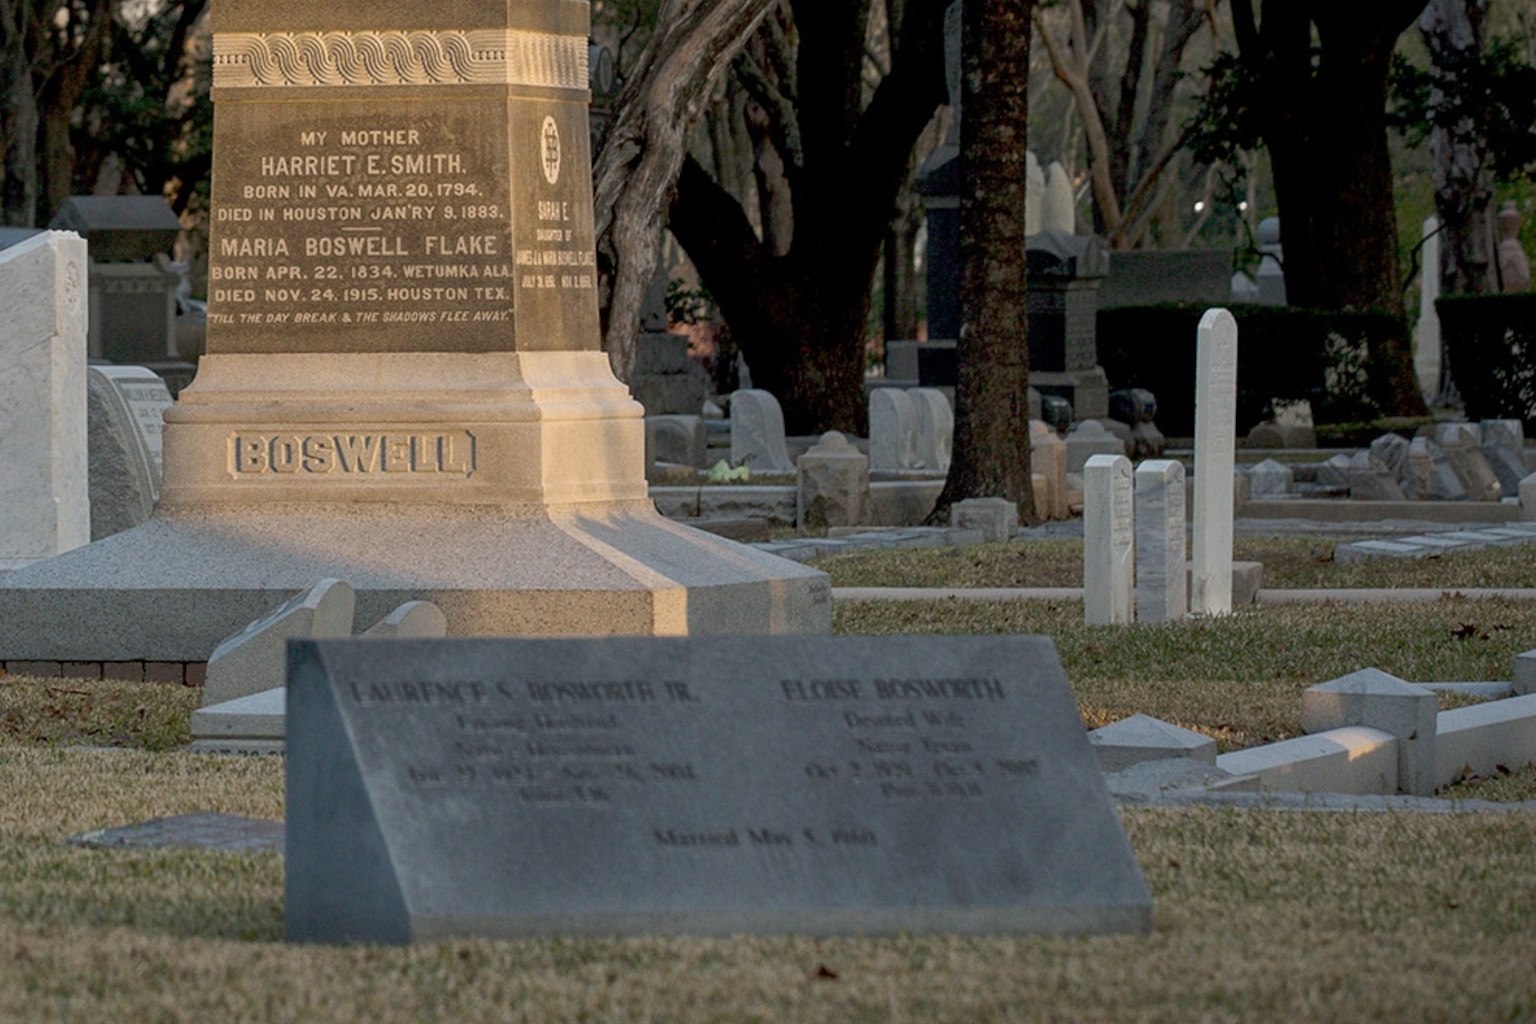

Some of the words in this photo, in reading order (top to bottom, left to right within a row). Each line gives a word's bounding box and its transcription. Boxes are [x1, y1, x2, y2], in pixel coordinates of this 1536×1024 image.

[300, 131, 328, 146] MY
[341, 129, 420, 146] MOTHER
[261, 155, 357, 177] HARRIET
[367, 155, 386, 176] E.
[390, 154, 467, 176] SMITH.
[243, 185, 290, 199] BORN
[298, 185, 317, 199] IN
[326, 185, 354, 199] VA.
[357, 184, 402, 199] MAR.
[437, 183, 483, 198] 1794.
[217, 208, 252, 221] DIED
[259, 207, 275, 221] IN
[283, 207, 361, 221] HOUSTON
[369, 204, 436, 221] JAN'RY
[461, 205, 504, 220] 1883.
[221, 237, 289, 257] MARIA
[305, 236, 409, 257] BOSWELL
[425, 235, 498, 256] FLAKE
[211, 266, 258, 280] BORN
[265, 265, 308, 280] APR.
[351, 264, 398, 280] 1834.
[403, 264, 479, 279] WETUMKA
[482, 264, 513, 278] ALA.
[214, 288, 256, 302] DIED
[265, 288, 306, 302] NOV.
[343, 287, 383, 302] 1915.
[387, 287, 468, 301] HOUSTON
[473, 287, 510, 301] TEX.
[239, 313, 263, 324] THE
[265, 313, 291, 324] DAY
[294, 312, 337, 324] BREAK
[342, 312, 352, 324] &
[355, 311, 379, 324] THE
[382, 310, 437, 323] SHADOWS
[439, 310, 469, 323] FLEE
[234, 434, 465, 474] BOSWELL
[779, 678, 864, 701] ELOISE
[872, 677, 1006, 701] BOSWORTH
